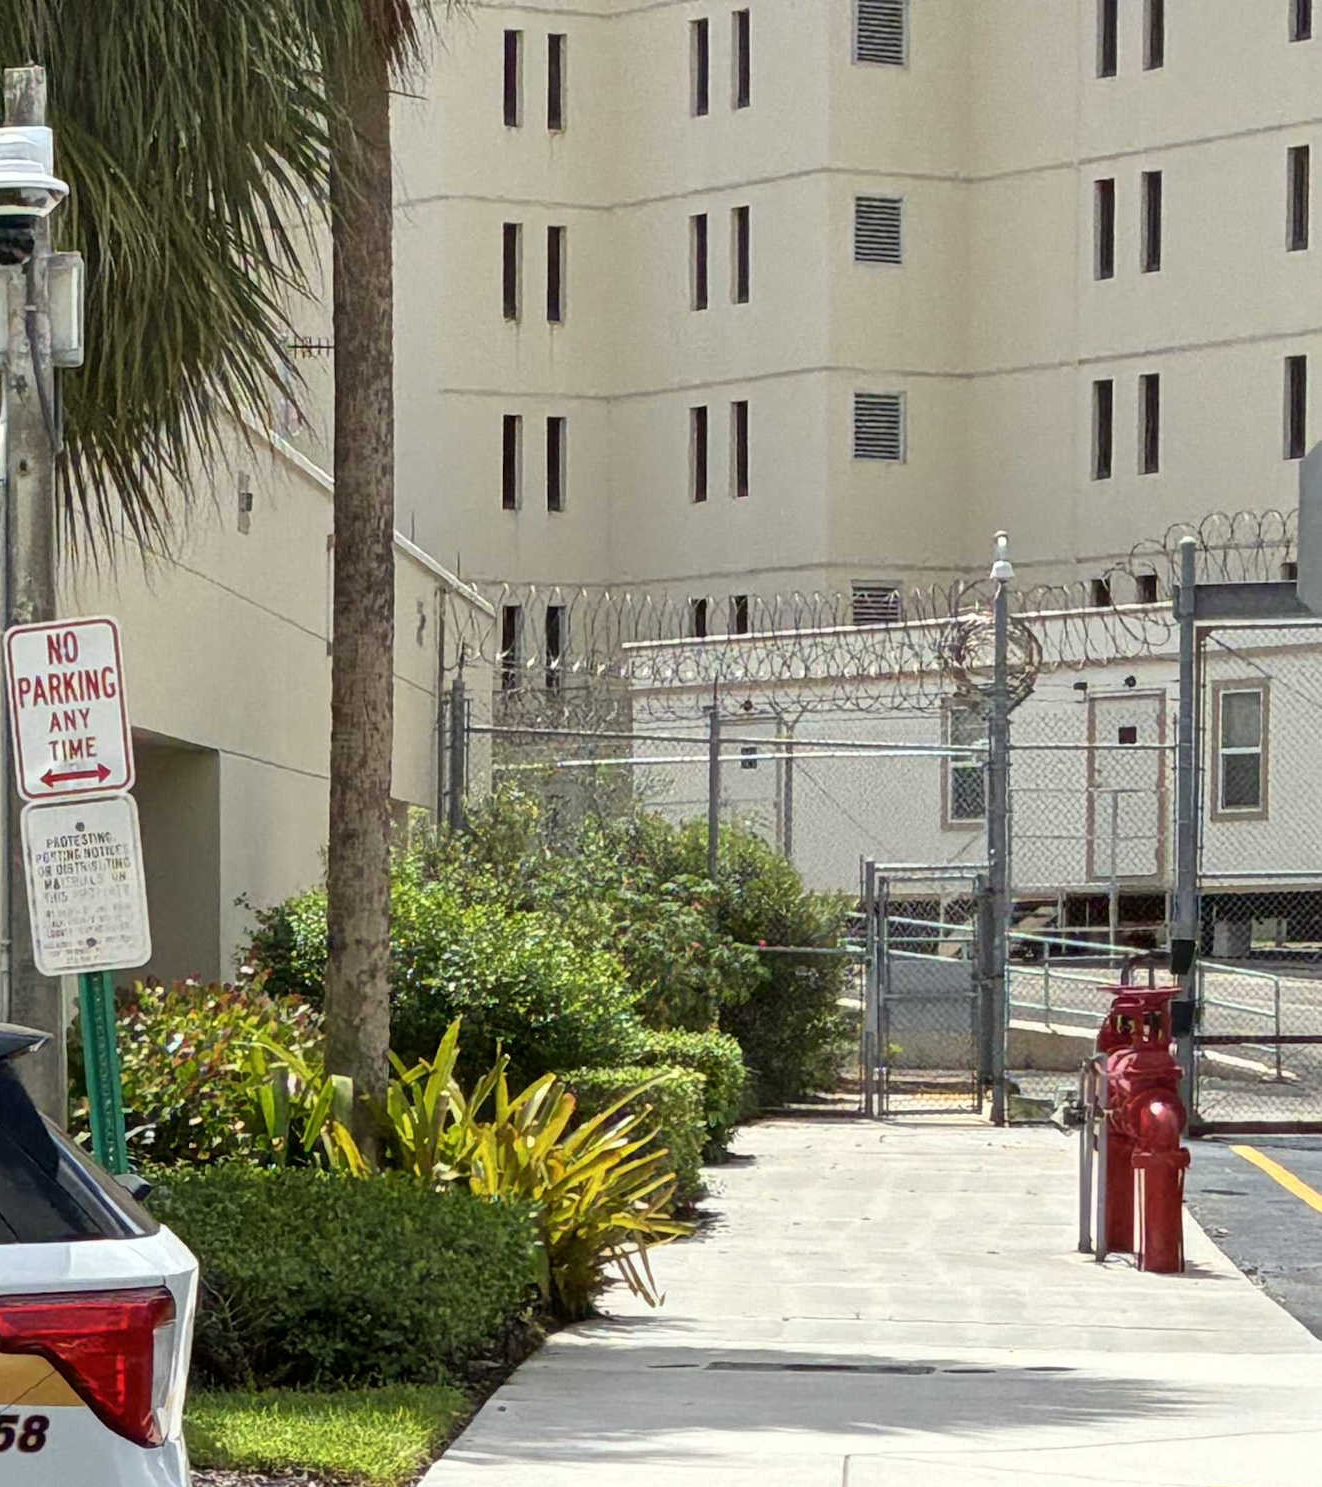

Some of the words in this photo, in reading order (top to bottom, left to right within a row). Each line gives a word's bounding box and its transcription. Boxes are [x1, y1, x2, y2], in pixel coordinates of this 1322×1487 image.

[47, 631, 78, 665] NO
[18, 666, 116, 708] PARKING
[49, 707, 90, 733] ANY
[48, 736, 97, 761] TIME
